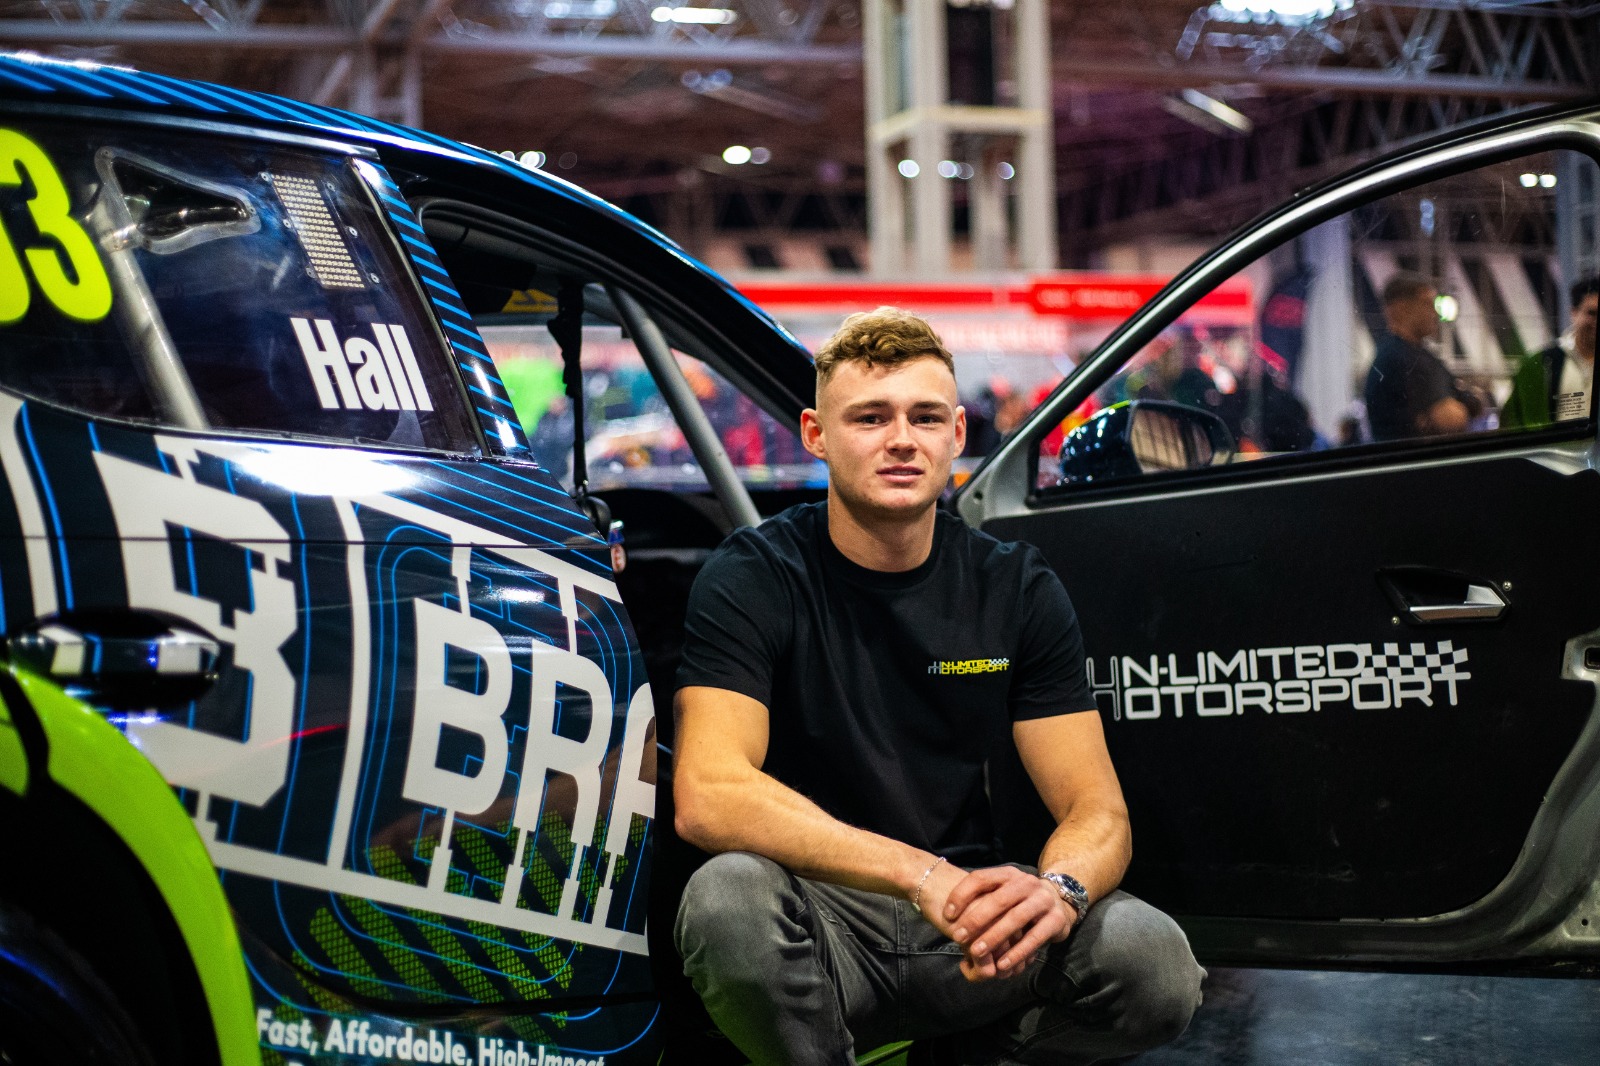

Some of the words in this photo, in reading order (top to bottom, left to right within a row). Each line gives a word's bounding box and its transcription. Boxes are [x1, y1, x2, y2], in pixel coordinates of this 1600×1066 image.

[0, 127, 113, 323] 3
[290, 317, 434, 411] Hall
[256, 1008, 319, 1056] Fast,
[324, 1018, 472, 1066] Affordable,
